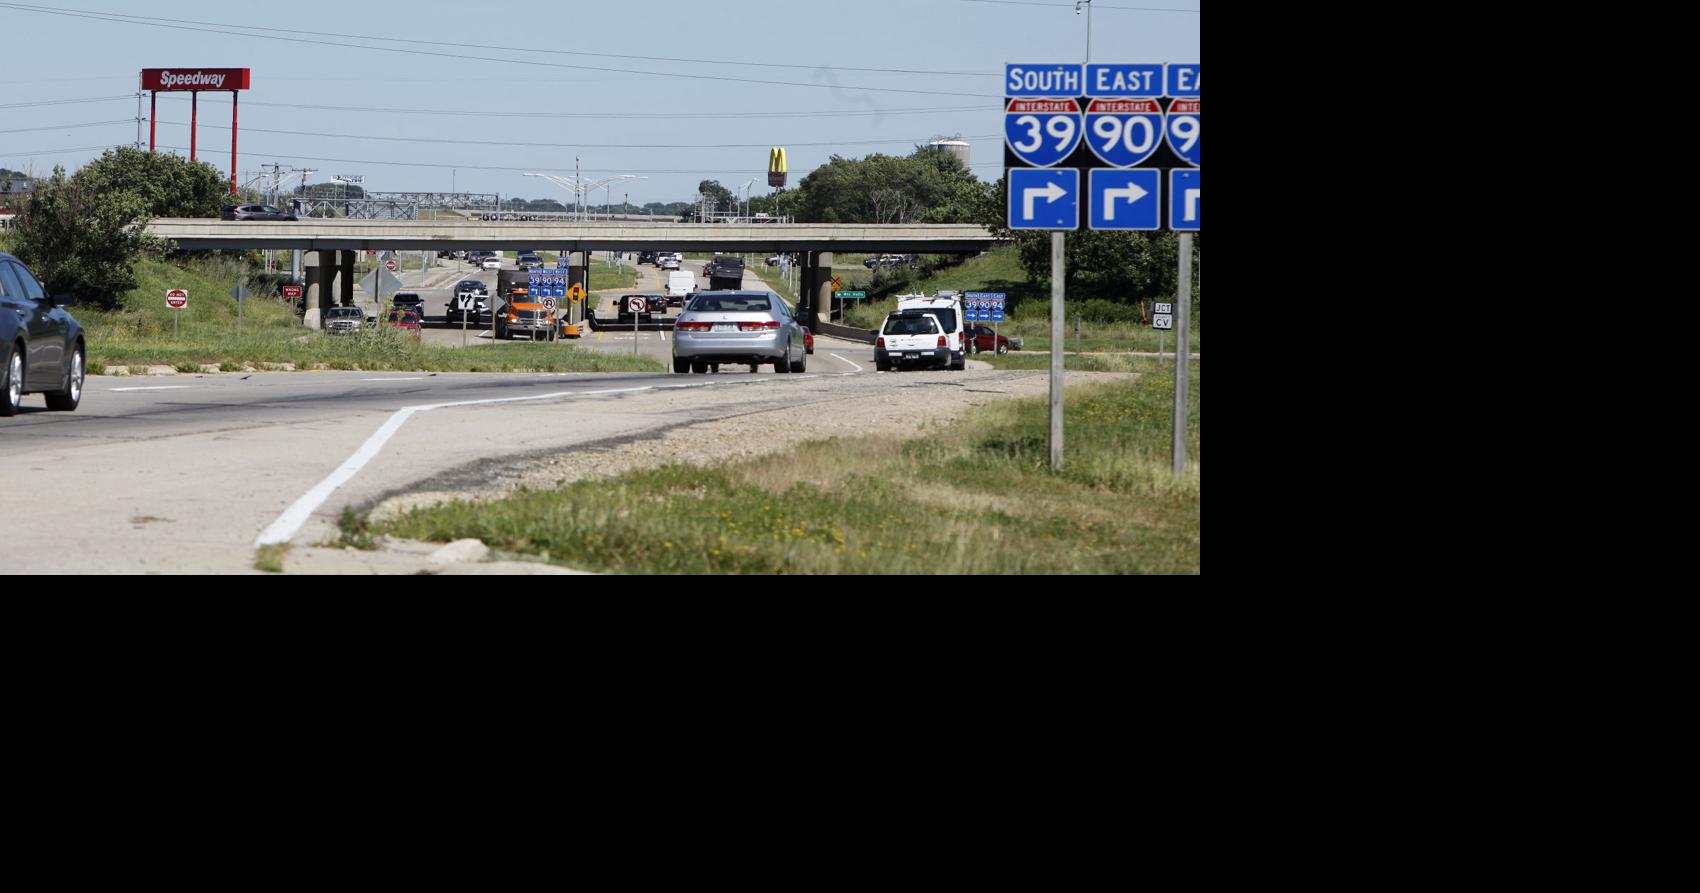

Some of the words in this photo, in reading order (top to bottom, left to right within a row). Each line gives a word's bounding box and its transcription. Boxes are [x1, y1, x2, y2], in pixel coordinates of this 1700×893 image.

[160, 71, 226, 88] Speedway
[1008, 68, 1078, 91] SOUTH
[1096, 68, 1154, 91] EAST
[1015, 103, 1070, 112] INTERSTATE
[1096, 103, 1151, 112] INTERSTATE
[1014, 115, 1075, 153] 39
[1093, 115, 1154, 153] 90
[1171, 115, 1200, 153] 9
[553, 277, 564, 285] 94
[979, 301, 990, 309] 90
[992, 301, 1004, 309] 94
[1156, 304, 1170, 312] JCT
[1155, 318, 1169, 327] CV
